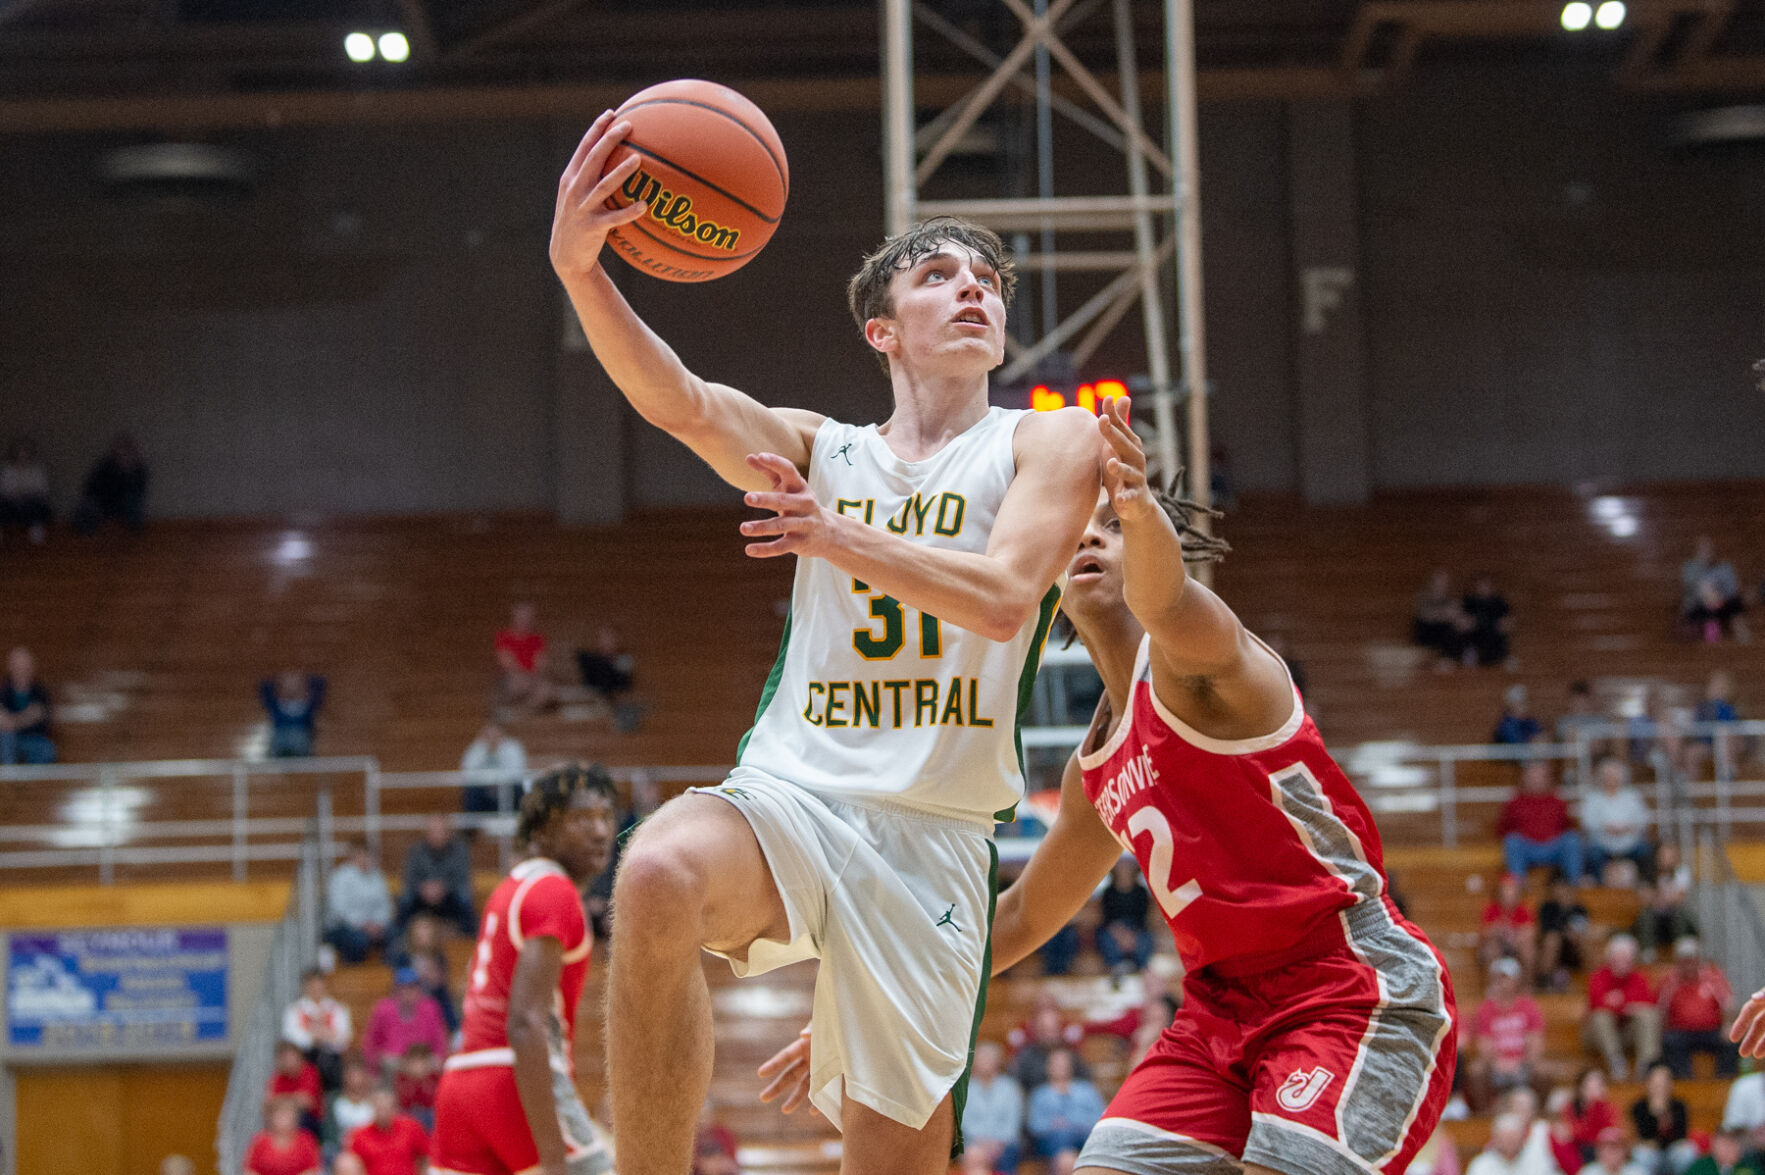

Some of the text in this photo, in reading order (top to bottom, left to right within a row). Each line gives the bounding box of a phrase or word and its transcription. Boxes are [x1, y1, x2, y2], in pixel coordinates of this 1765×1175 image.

[622, 168, 741, 250] Wilson
[610, 228, 715, 280] VOLUTION
[1302, 267, 1352, 333] F
[803, 677, 995, 729] CENTRAL
